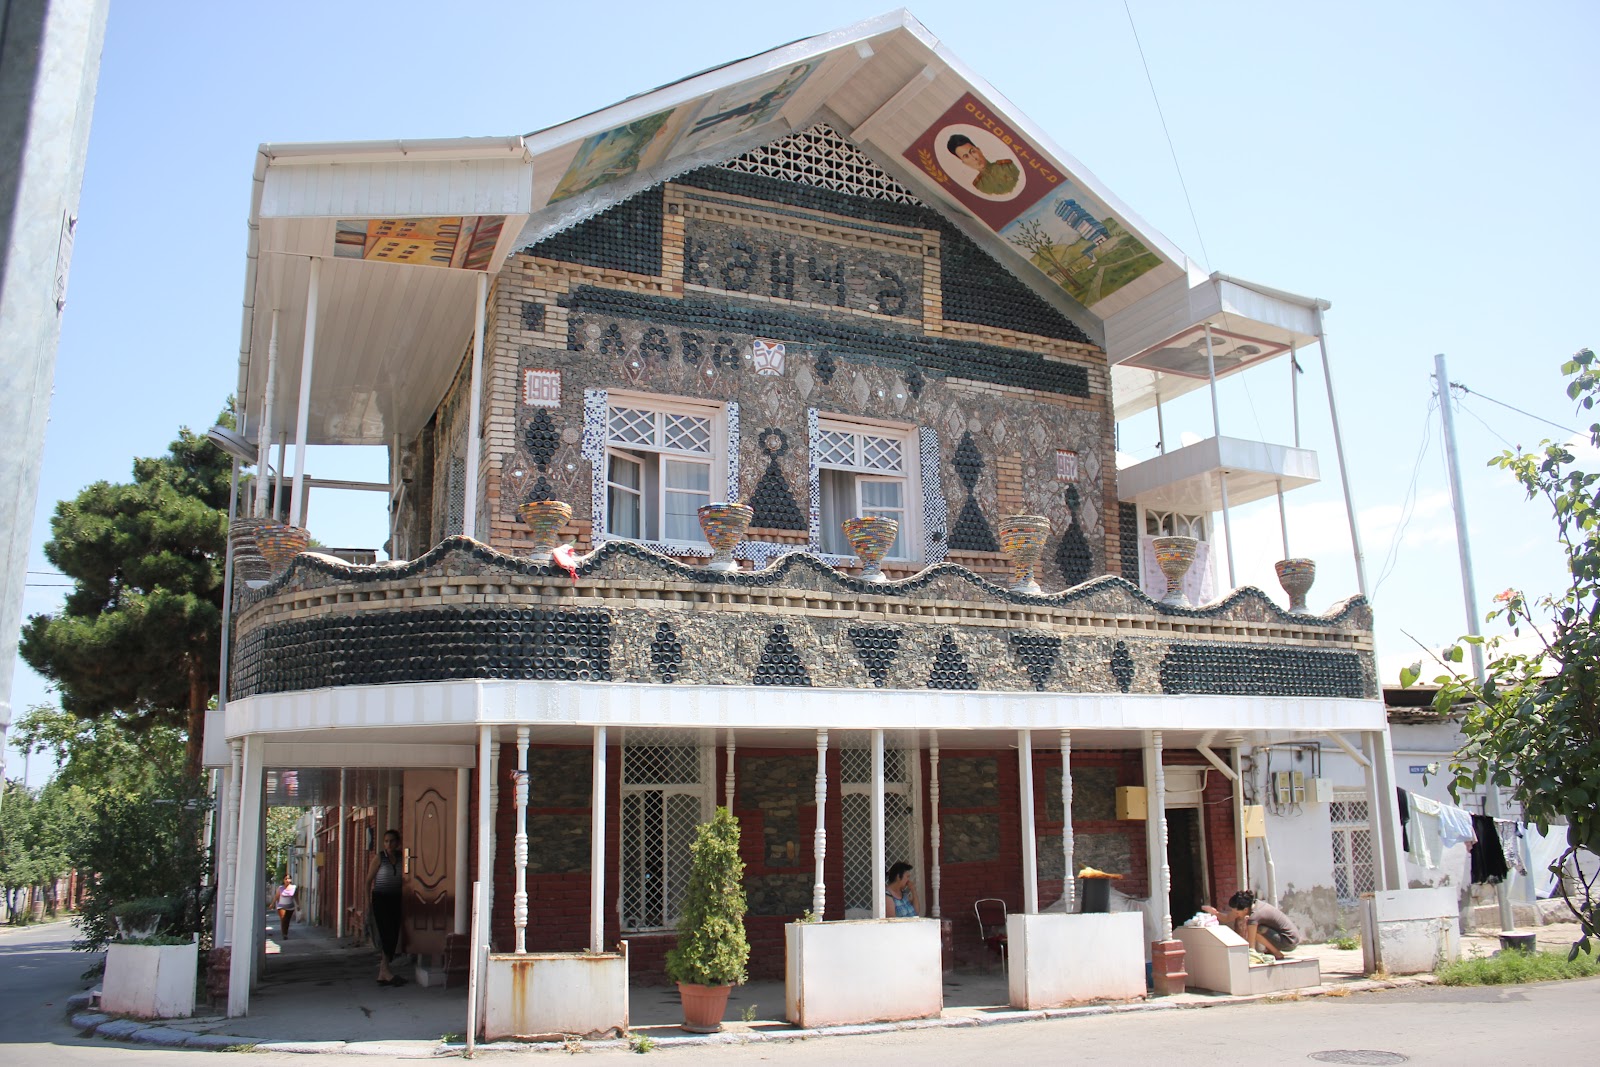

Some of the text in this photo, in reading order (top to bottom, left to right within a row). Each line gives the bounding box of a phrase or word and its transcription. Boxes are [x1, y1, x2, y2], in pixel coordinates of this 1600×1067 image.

[965, 102, 1058, 183] ОСНОВАТЕЛЬ
[754, 347, 785, 370] 50
[527, 374, 559, 401] 1966
